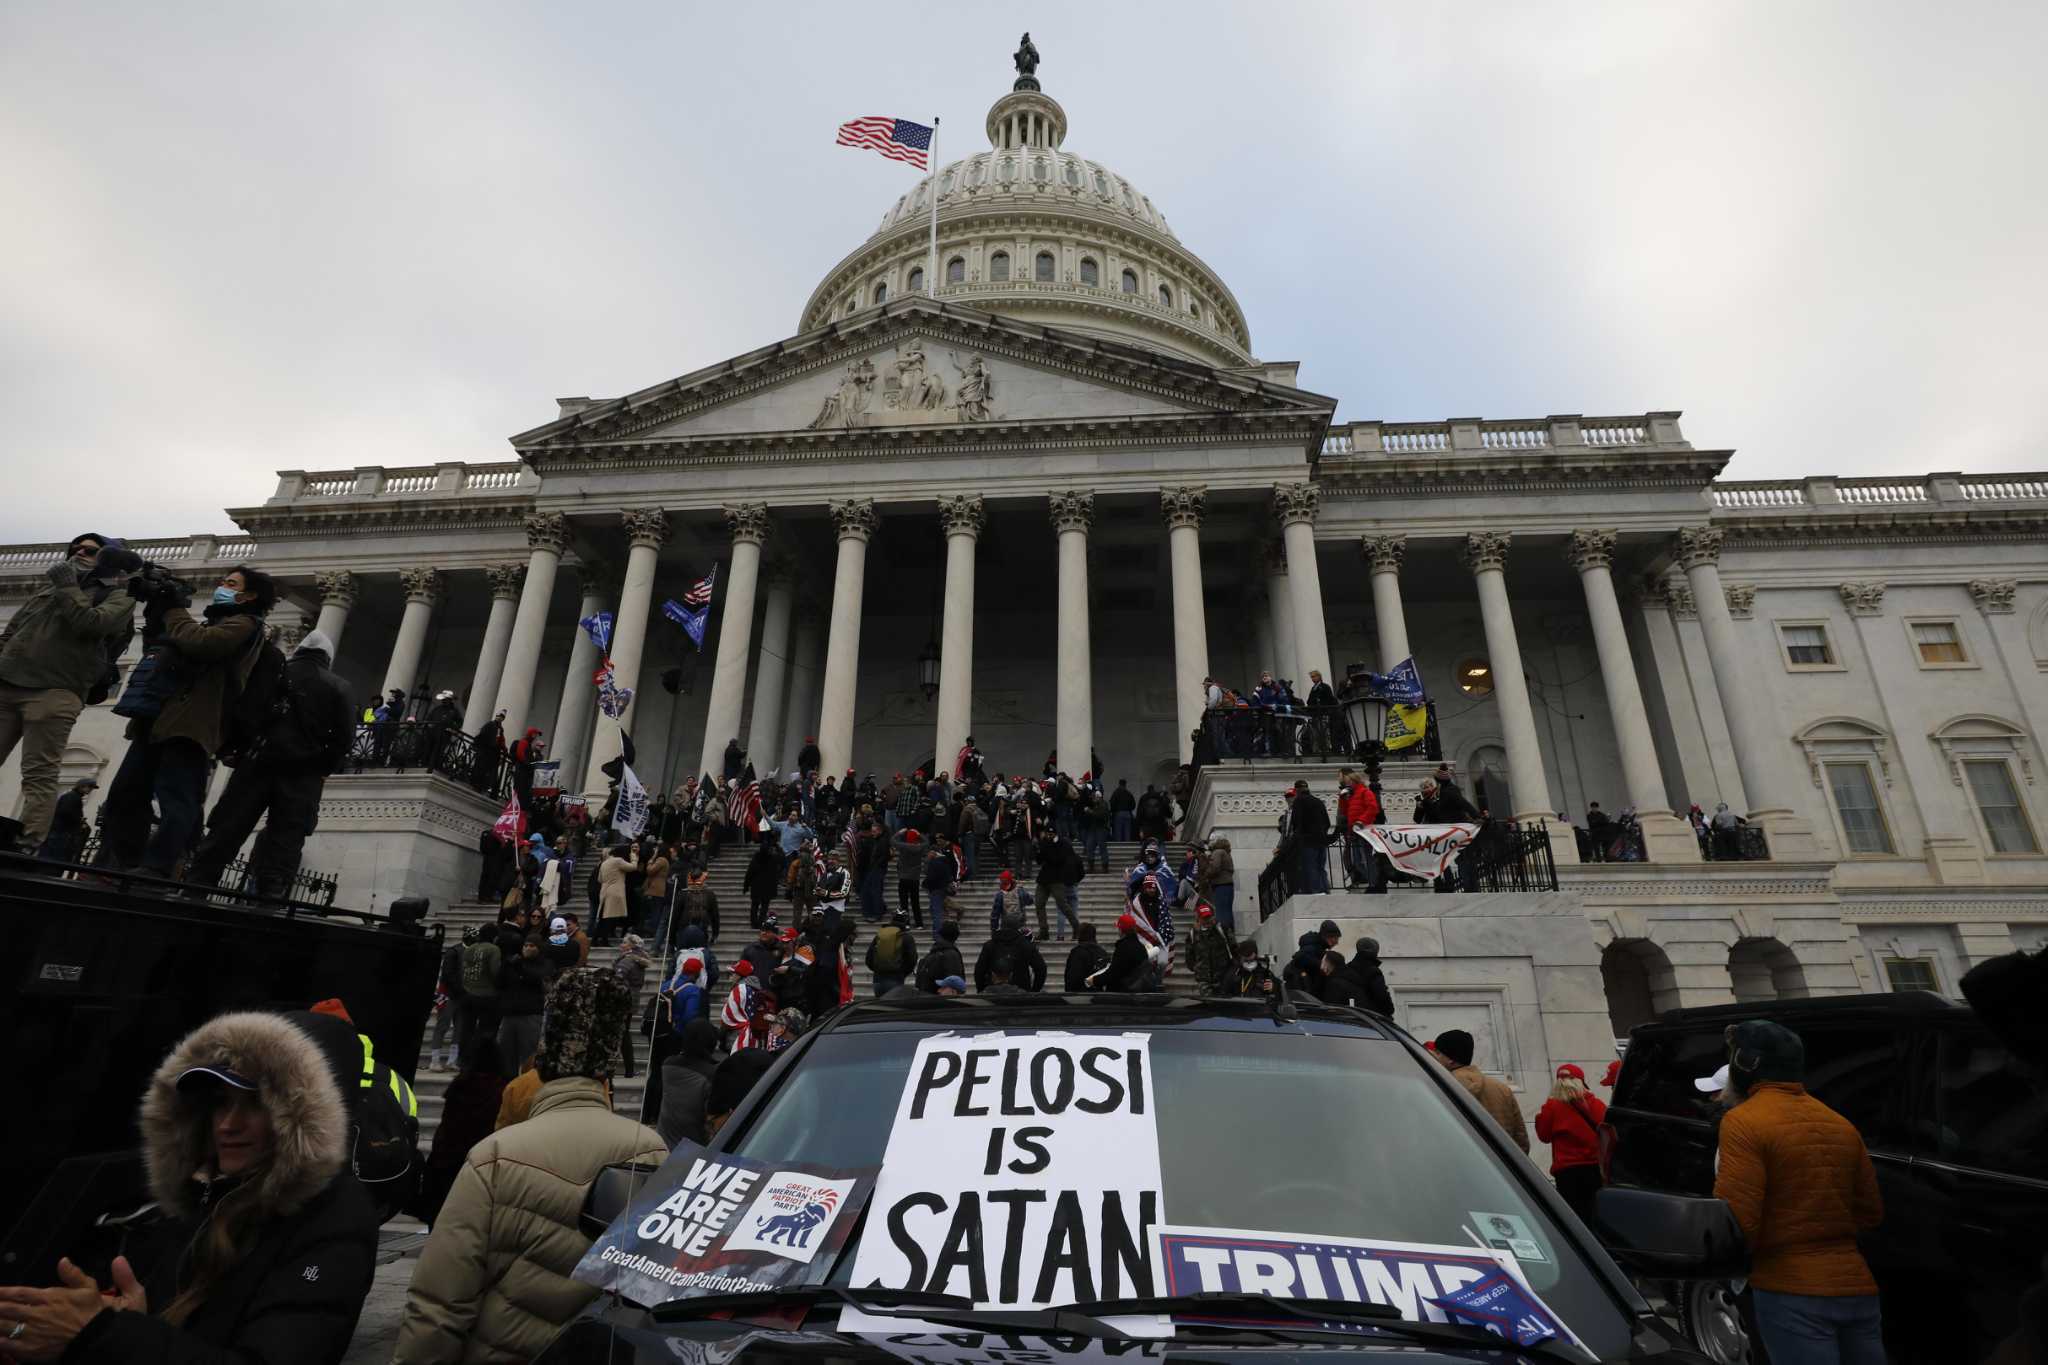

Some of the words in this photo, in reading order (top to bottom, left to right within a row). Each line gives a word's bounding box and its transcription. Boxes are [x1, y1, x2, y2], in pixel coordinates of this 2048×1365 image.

[562, 796, 585, 806] TRUMP
[910, 1046, 1145, 1120] PELOSI
[984, 1126, 1055, 1176] IS
[682, 1158, 760, 1203] WE
[767, 1187, 808, 1200] AMERICAN
[771, 1194, 804, 1205] PATRIOT
[785, 1183, 812, 1193] GREAT
[656, 1189, 739, 1231] ARE
[774, 1202, 800, 1212] PARTY
[636, 1213, 720, 1257] ONE
[866, 1189, 1157, 1305] SATAN
[600, 1245, 781, 1294] GreatAmericanPatriotParty
